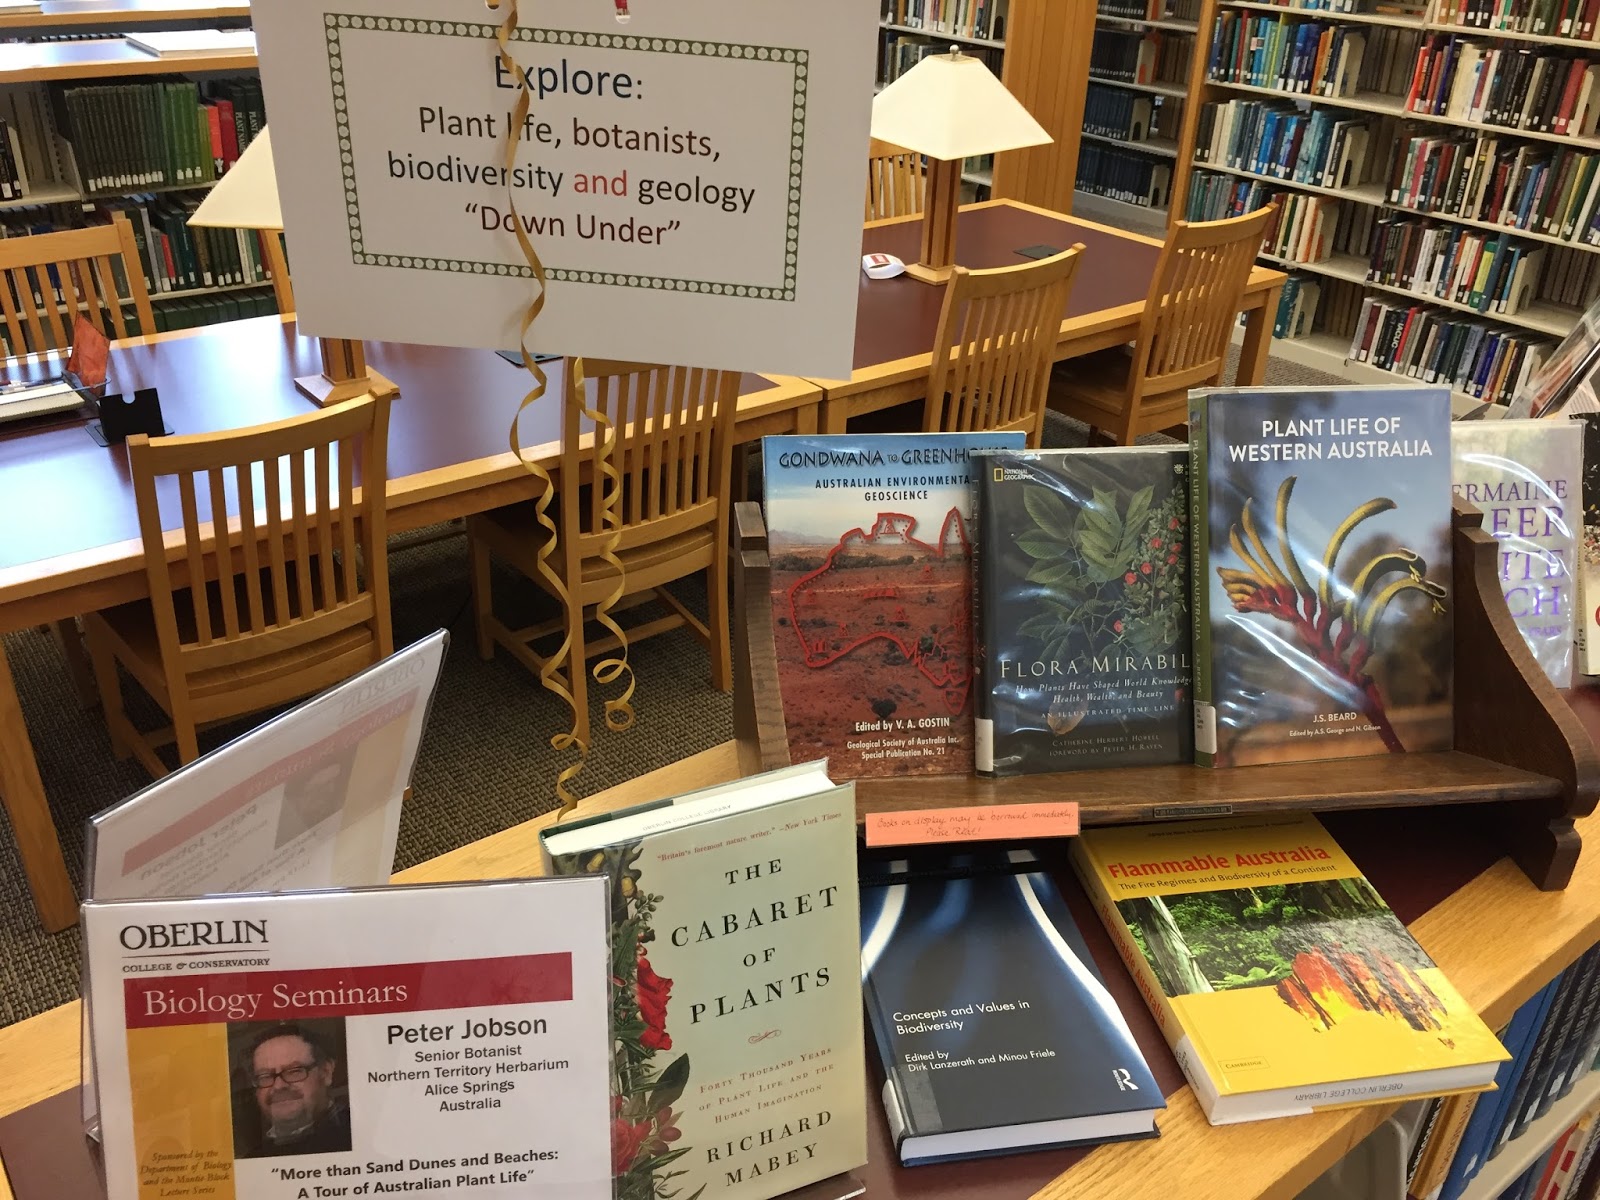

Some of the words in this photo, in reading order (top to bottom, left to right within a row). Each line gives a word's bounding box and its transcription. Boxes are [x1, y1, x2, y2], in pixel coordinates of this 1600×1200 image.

[495, 55, 642, 100] Explore:
[419, 106, 497, 139] Plant
[507, 112, 561, 149] lfe,
[573, 117, 720, 162] botanists,
[387, 150, 563, 197] biodiversity
[574, 169, 627, 197] and
[638, 175, 755, 214] geology
[465, 203, 565, 236] “Down
[576, 214, 681, 245] Under”
[1262, 419, 1325, 438] PLANT
[1330, 417, 1369, 436] LIFE
[1374, 416, 1401, 435] OF
[779, 450, 884, 468] GONDWANA
[901, 447, 1008, 467] GREENH
[1192, 439, 1200, 476] PLANT
[1229, 442, 1322, 463] WESTERN
[1327, 439, 1433, 459] AUSTRALIA
[815, 478, 882, 489] AUSTRALIAN
[887, 475, 970, 486] ENVIRONMENTA
[1192, 478, 1200, 502] LIFE
[1452, 480, 1568, 502] ERMAINE
[864, 490, 928, 501] GEOSCIENCE
[1192, 504, 1200, 525] OF
[1192, 526, 1201, 577] WESTERN
[1193, 579, 1201, 641] AUSTRALIA
[1000, 658, 1080, 678] FLORA
[1092, 653, 1191, 673] MIRABIL
[1038, 683, 1065, 693] Plants
[1069, 681, 1090, 691] Have
[1093, 679, 1120, 690] Shaped
[1123, 677, 1147, 687] World
[1052, 693, 1083, 703] Health,
[1118, 691, 1133, 700] and
[1136, 689, 1163, 700] Beauty
[855, 720, 880, 732] Edited
[883, 720, 893, 733] by
[896, 719, 904, 730] V.
[907, 719, 916, 729] A.
[918, 717, 950, 728] GOSTIN
[1313, 714, 1326, 723] J.S.
[1328, 712, 1357, 722] BEARD
[847, 740, 881, 750] Geological
[882, 739, 906, 749] Society
[908, 737, 915, 746] of
[917, 736, 946, 746] Australia
[948, 736, 960, 744] Inc.
[1326, 727, 1344, 735] George
[861, 751, 884, 761] Special
[886, 748, 921, 759] Publication
[923, 748, 934, 756] No.
[936, 747, 945, 755] 21
[694, 841, 723, 854] foremost
[726, 836, 747, 846] nature
[802, 817, 819, 827] York
[822, 811, 842, 822] Times
[725, 858, 782, 885] THE
[1107, 854, 1231, 879] Flammable
[1235, 846, 1332, 868] Australia
[1118, 880, 1136, 891] The
[1138, 878, 1155, 889] Fire
[1157, 875, 1198, 889] Regimes
[1199, 873, 1216, 883] and
[1219, 867, 1270, 882] Biodiversity
[1272, 867, 1282, 877] of
[1291, 864, 1337, 875] Continent
[671, 885, 838, 947] CABARET
[119, 919, 270, 951] OBERLIN
[122, 962, 172, 973] COLLEGE
[188, 957, 270, 970] CONSERVATORY
[743, 947, 776, 967] OF
[142, 987, 263, 1020] Biology
[272, 980, 408, 1009] Seminars
[689, 967, 831, 1025] PLANTS
[892, 1008, 947, 1023] Concepts
[951, 1004, 974, 1016] and
[975, 1001, 1016, 1014] Values
[1018, 999, 1030, 1010] in
[387, 1024, 454, 1045] Peter
[461, 1017, 547, 1040] Jobson
[896, 1019, 964, 1035] Biodiversity
[414, 1050, 460, 1063] Senior
[464, 1044, 522, 1059] Botanist
[904, 1051, 935, 1063] Edited
[937, 1051, 950, 1062] by
[907, 1062, 928, 1073] Dirk
[930, 1057, 976, 1071] Lanzerath
[977, 1055, 997, 1065] and
[998, 1052, 1028, 1063] Minou
[1030, 1048, 1056, 1060] Friele
[1225, 1060, 1263, 1069] CAMBRIDGE
[367, 1070, 430, 1084] Northern
[434, 1065, 492, 1079] Territory
[495, 1059, 569, 1075] Herbarium
[700, 1079, 734, 1094] FORTY
[740, 1060, 794, 1081] THOUSAND
[800, 1047, 832, 1062] YEARS
[424, 1083, 459, 1096] Alice
[462, 1080, 515, 1095] Springs
[698, 1103, 712, 1111] OF
[719, 1090, 752, 1105] PLANT
[759, 1081, 783, 1093] LIFE
[790, 1072, 809, 1082] AND
[815, 1063, 834, 1075] THE
[1293, 1090, 1327, 1101] LIBRARY
[1329, 1087, 1366, 1098] COLLEGE
[1368, 1083, 1403, 1093] OBERLIN
[439, 1098, 501, 1112] Australia
[714, 1107, 751, 1124] HUMAN
[757, 1084, 822, 1110] IMAGINATION
[706, 1110, 832, 1164] RICHARD
[271, 1167, 322, 1182] “More
[326, 1164, 362, 1177] than
[366, 1160, 404, 1174] Sand
[409, 1157, 457, 1171] Dunes
[460, 1153, 489, 1167] and
[494, 1149, 559, 1165] Beaches:
[724, 1142, 818, 1186] MABEY
[297, 1188, 309, 1200] A
[313, 1185, 349, 1198] Tour
[353, 1181, 370, 1195] of
[373, 1176, 451, 1194] Australian
[456, 1173, 495, 1188] Plant
[500, 1169, 535, 1183] Life”
